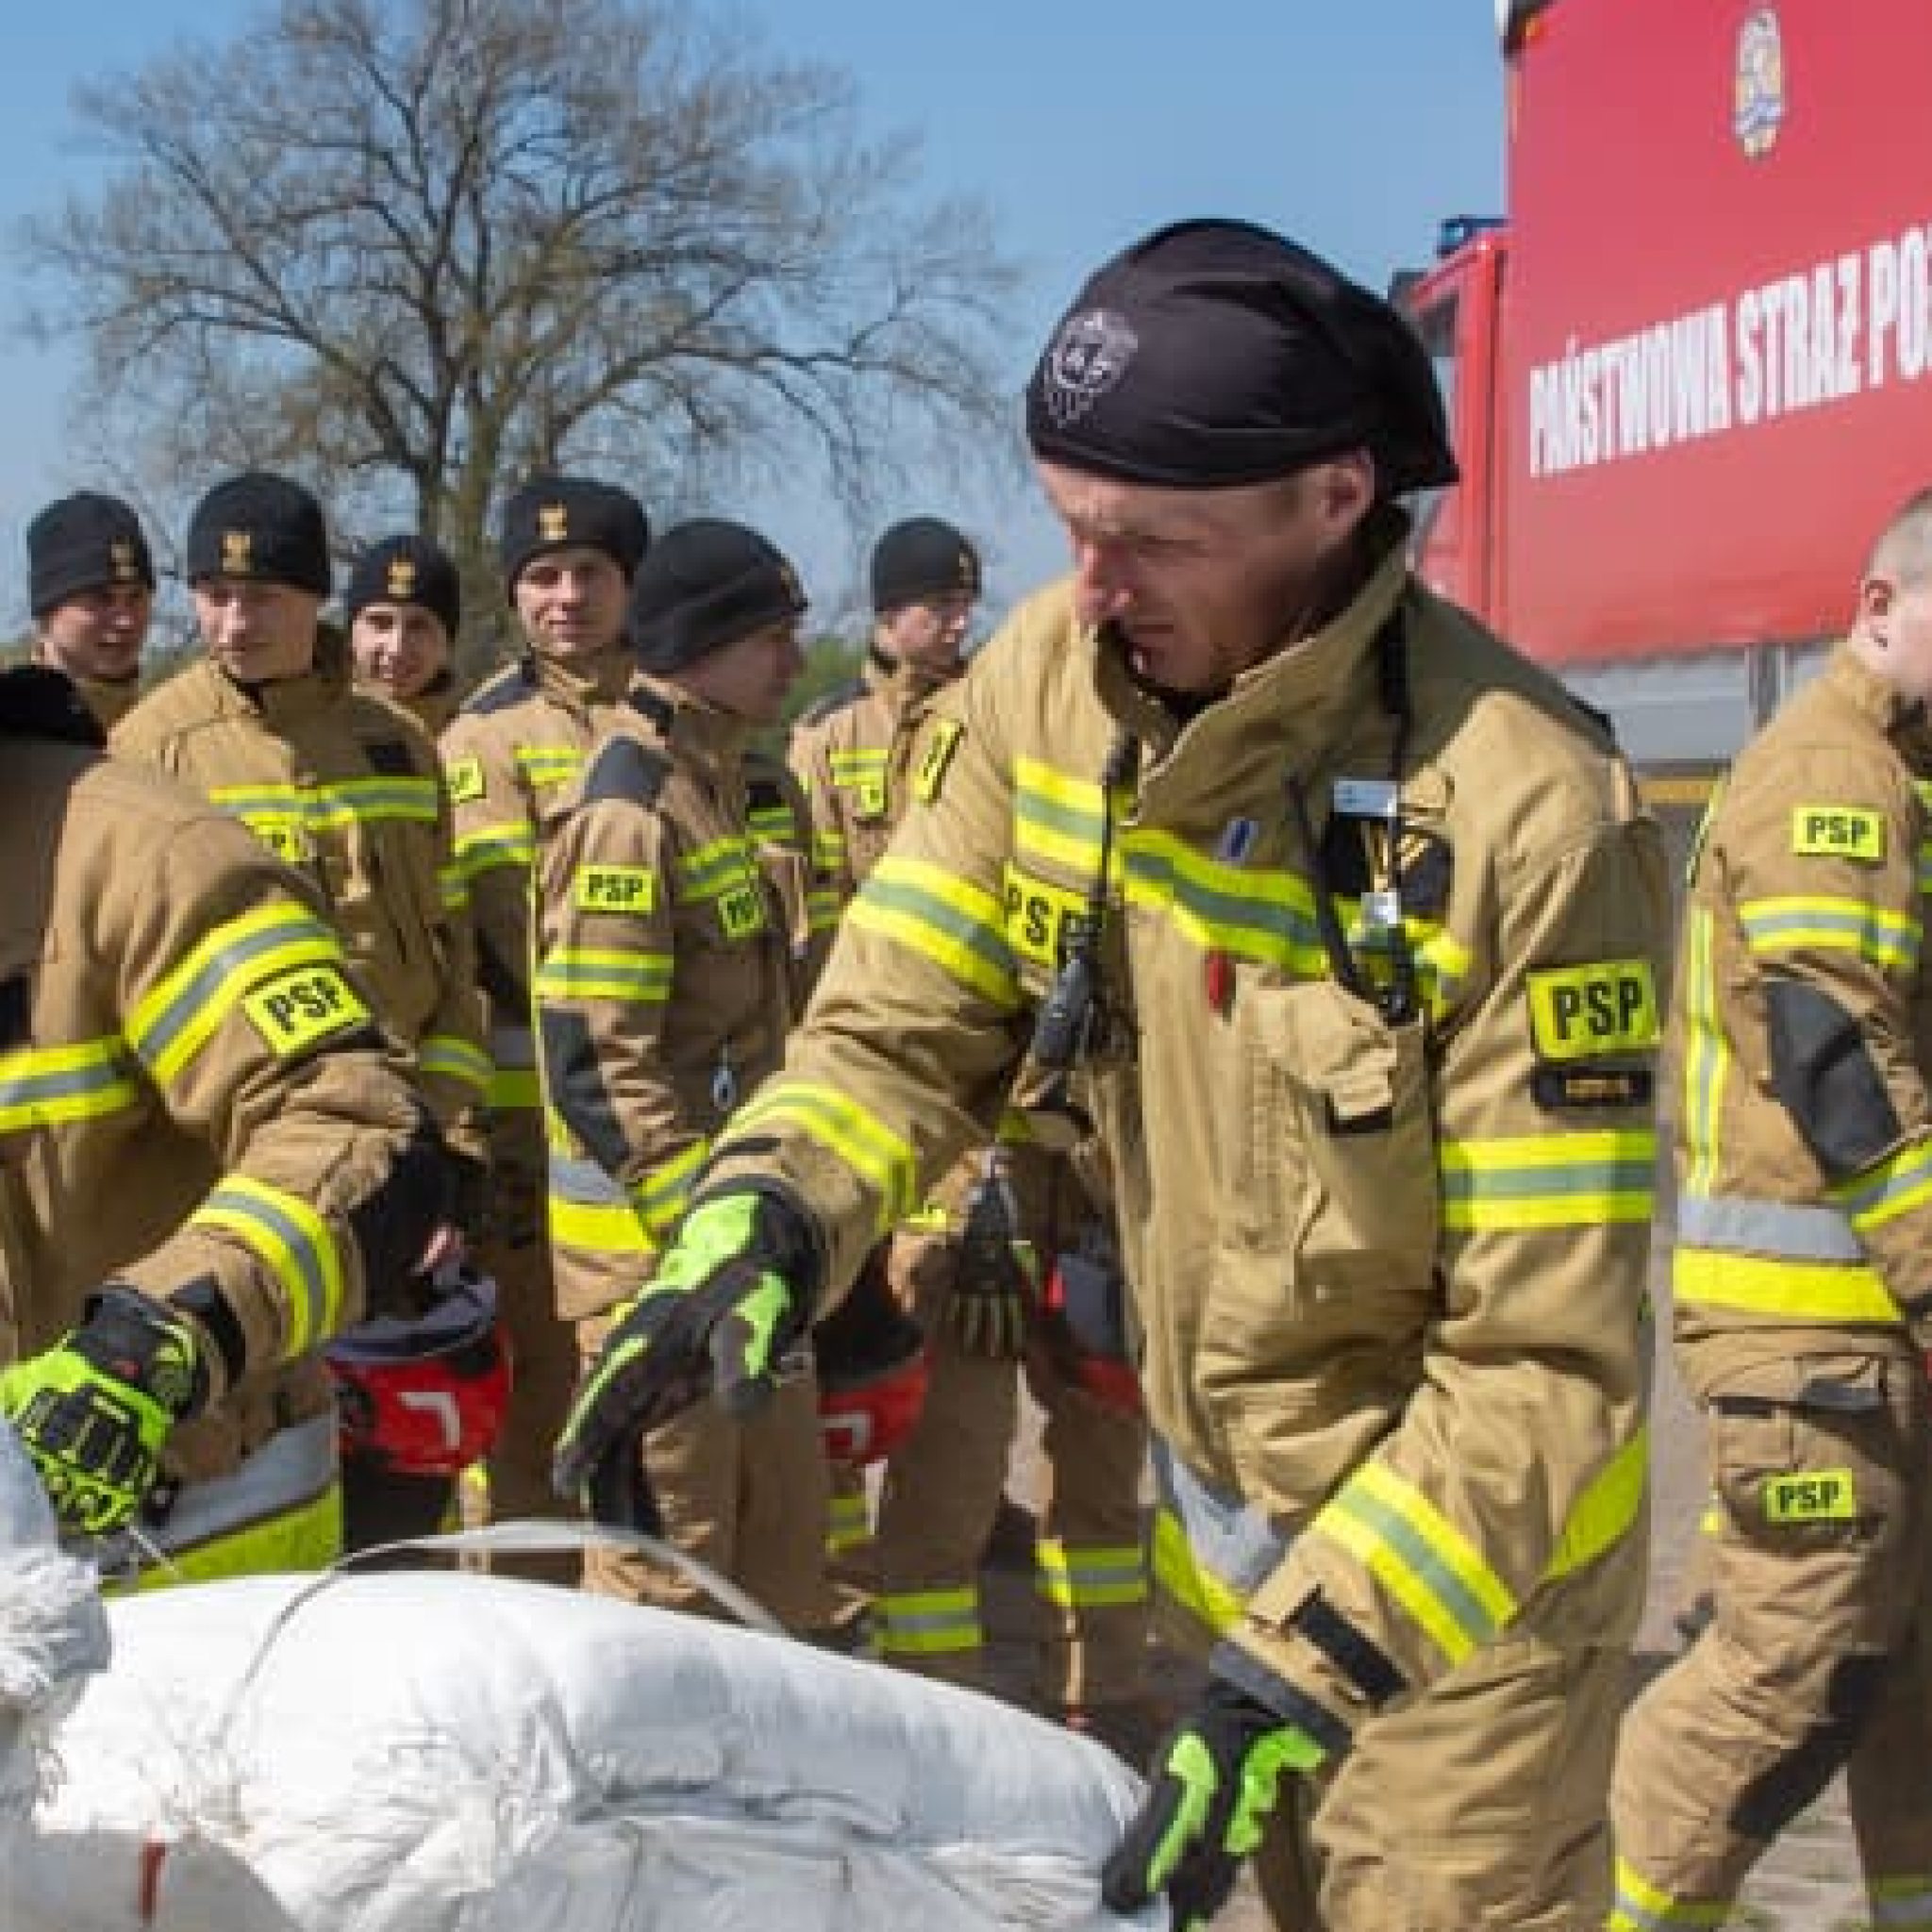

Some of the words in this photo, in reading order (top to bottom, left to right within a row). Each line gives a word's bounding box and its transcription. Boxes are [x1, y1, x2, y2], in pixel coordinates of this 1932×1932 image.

[1869, 219, 1932, 389] PO
[1806, 815, 1870, 848] PSP
[588, 874, 643, 903] PSP
[1550, 976, 1642, 1041] PSP
[1776, 1480, 1839, 1513] PSP
